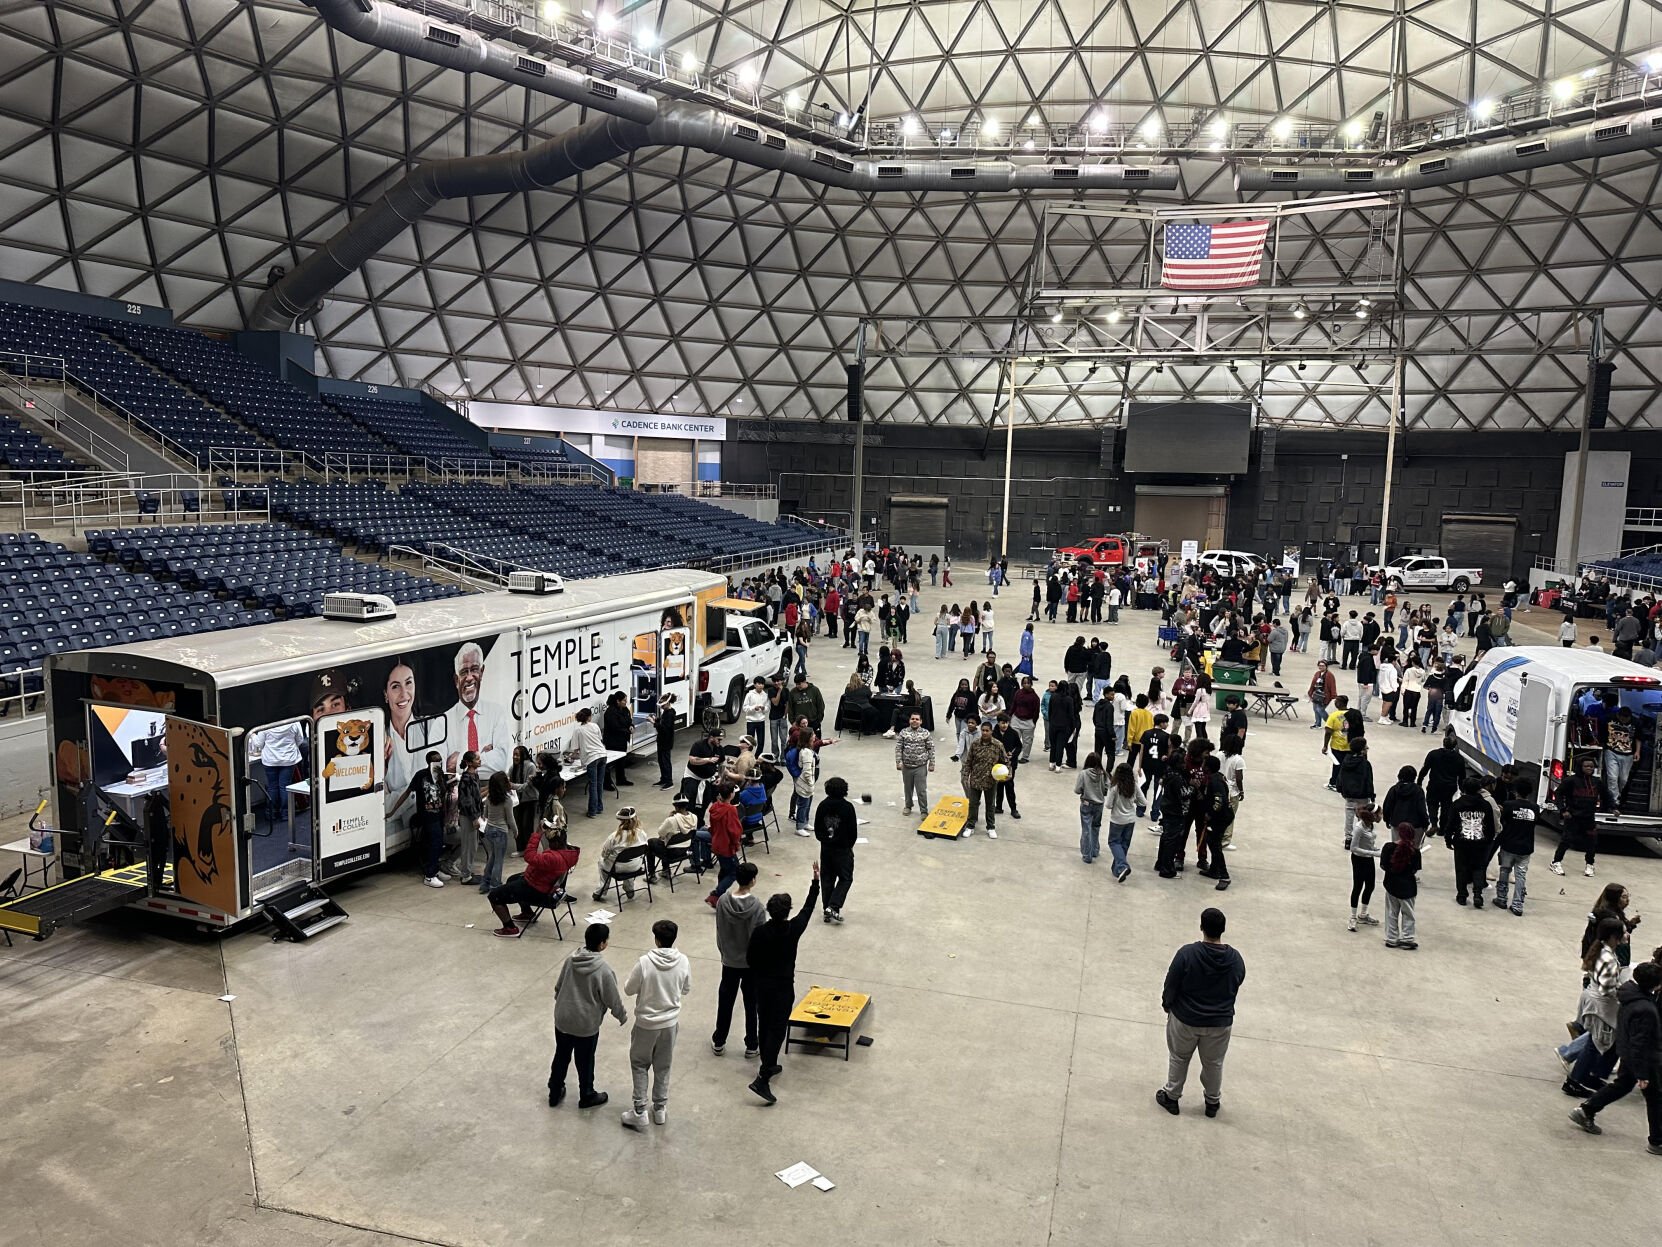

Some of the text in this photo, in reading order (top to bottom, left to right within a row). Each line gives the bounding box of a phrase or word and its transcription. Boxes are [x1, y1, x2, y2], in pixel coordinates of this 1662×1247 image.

[127, 304, 141, 315] 225
[367, 384, 378, 394] 226
[621, 420, 715, 433] CADENCE BANK CENTER
[510, 632, 601, 683] TEMPLE
[511, 662, 619, 721] COLLEGE
[533, 711, 576, 736] Communi
[1148, 745, 1159, 759] 4
[335, 765, 368, 778] WELCOME!
[342, 816, 364, 826] TEMPLE
[342, 819, 369, 831] COLLEGE
